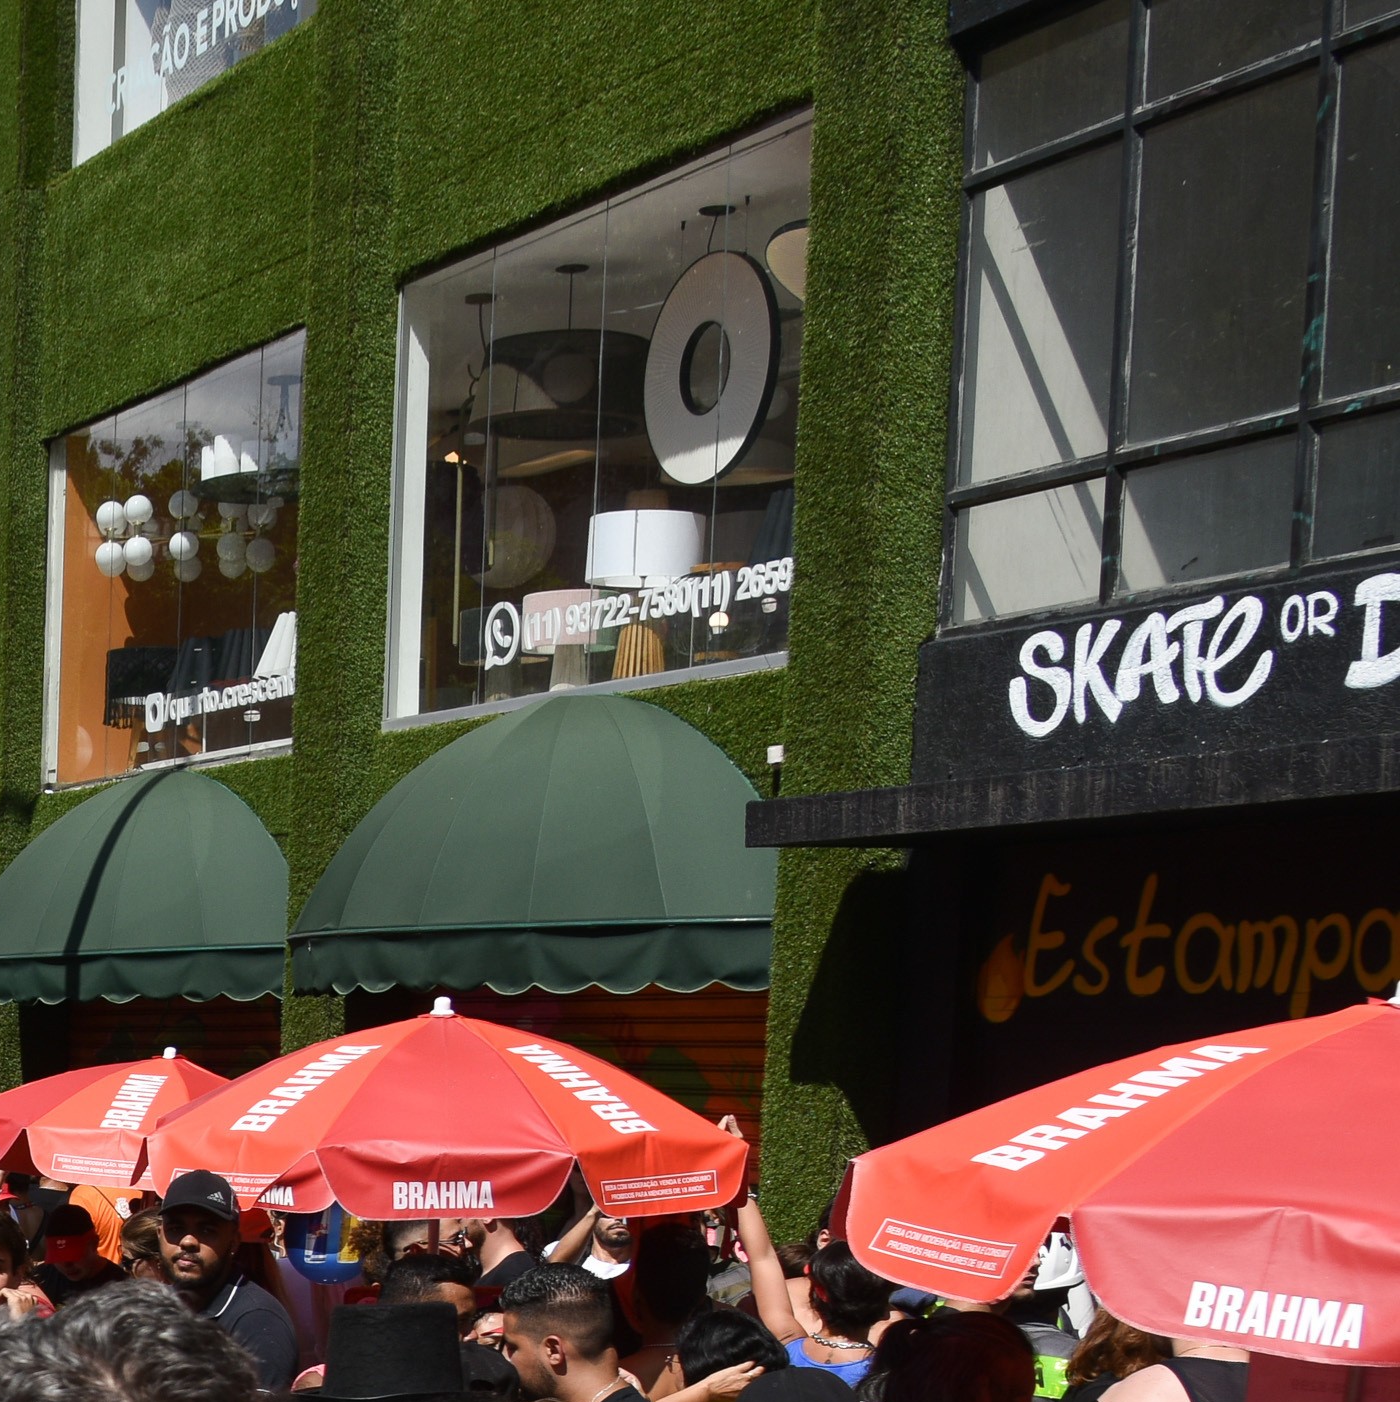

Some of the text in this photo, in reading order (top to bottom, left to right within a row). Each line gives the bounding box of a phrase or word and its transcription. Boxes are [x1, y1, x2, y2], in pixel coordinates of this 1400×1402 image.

[196, 8, 209, 56] E
[524, 606, 562, 651] (11)
[1280, 589, 1339, 644] OR
[99, 1073, 169, 1131] BRAHMA
[229, 1044, 383, 1133] BRAHMA
[508, 1043, 660, 1135] BRAHMA
[969, 1044, 1270, 1172] BRAHMA
[392, 1181, 495, 1210] BRAHMA
[1183, 1280, 1365, 1349] BRAHMA
